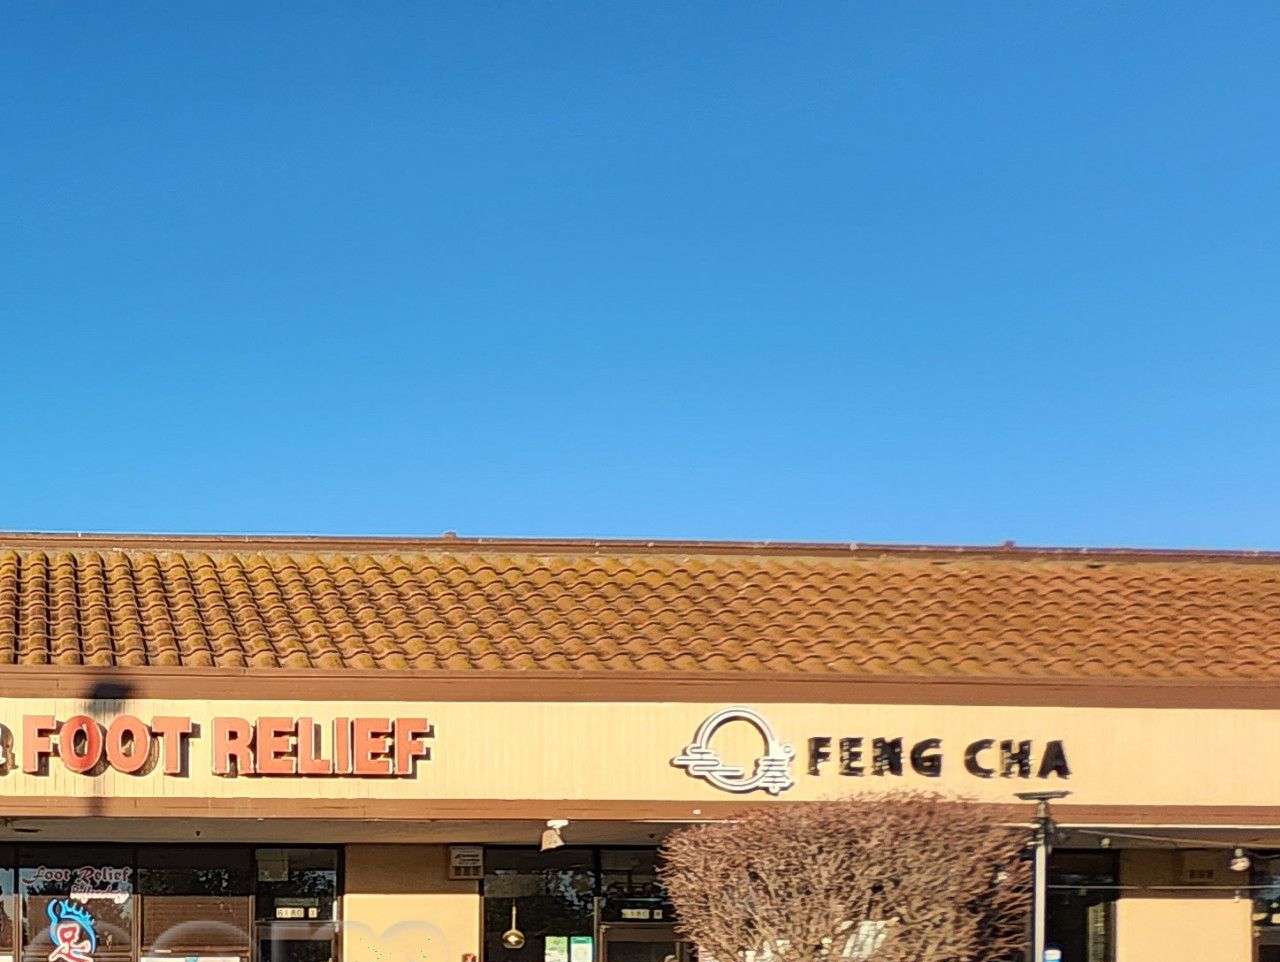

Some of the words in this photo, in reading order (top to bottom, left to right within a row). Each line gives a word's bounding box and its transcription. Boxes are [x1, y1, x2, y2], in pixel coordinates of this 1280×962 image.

[22, 715, 193, 775] FOOT
[212, 716, 430, 777] RELIEF
[807, 737, 943, 777] FENG
[964, 738, 1072, 779] CHA
[22, 867, 70, 885] Foot
[75, 866, 131, 884] Relief
